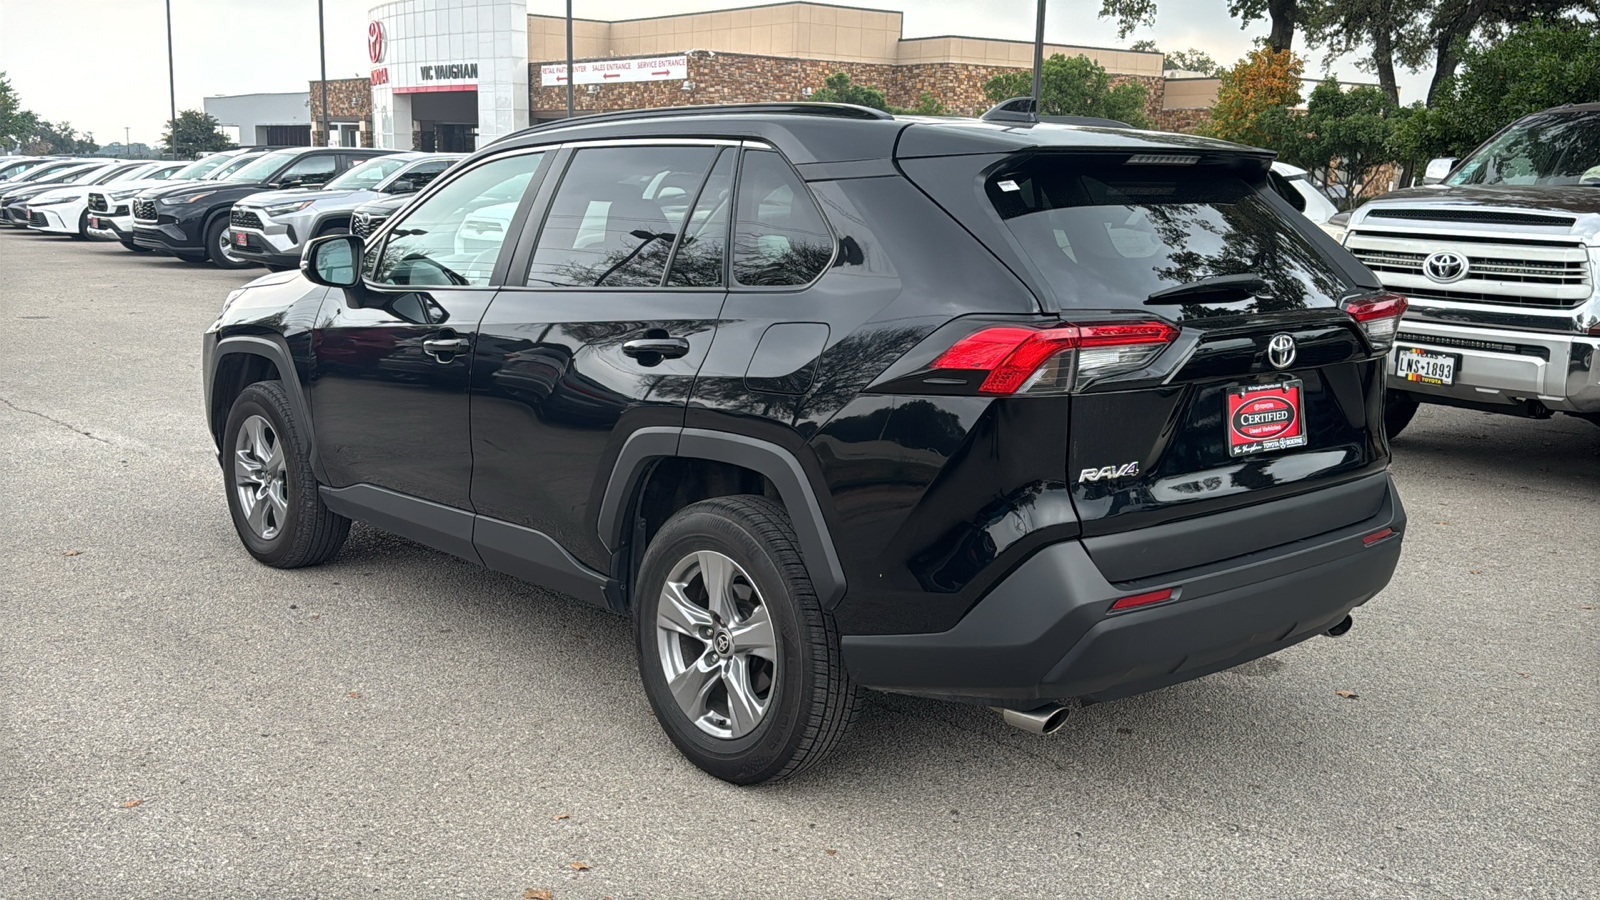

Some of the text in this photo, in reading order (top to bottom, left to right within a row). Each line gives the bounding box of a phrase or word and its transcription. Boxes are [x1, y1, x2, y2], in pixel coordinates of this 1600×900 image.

[592, 62, 631, 72] SALES ENTRANCE
[637, 58, 685, 69] SERVICE ENTRANCE
[420, 63, 478, 81] VIC VAUGHAN
[571, 65, 587, 73] ENTER
[1241, 411, 1288, 425] CERTIFIED
[1262, 425, 1282, 433] Vehicles
[1263, 441, 1279, 449] TOYOTA
[1078, 460, 1140, 483] RAV4
